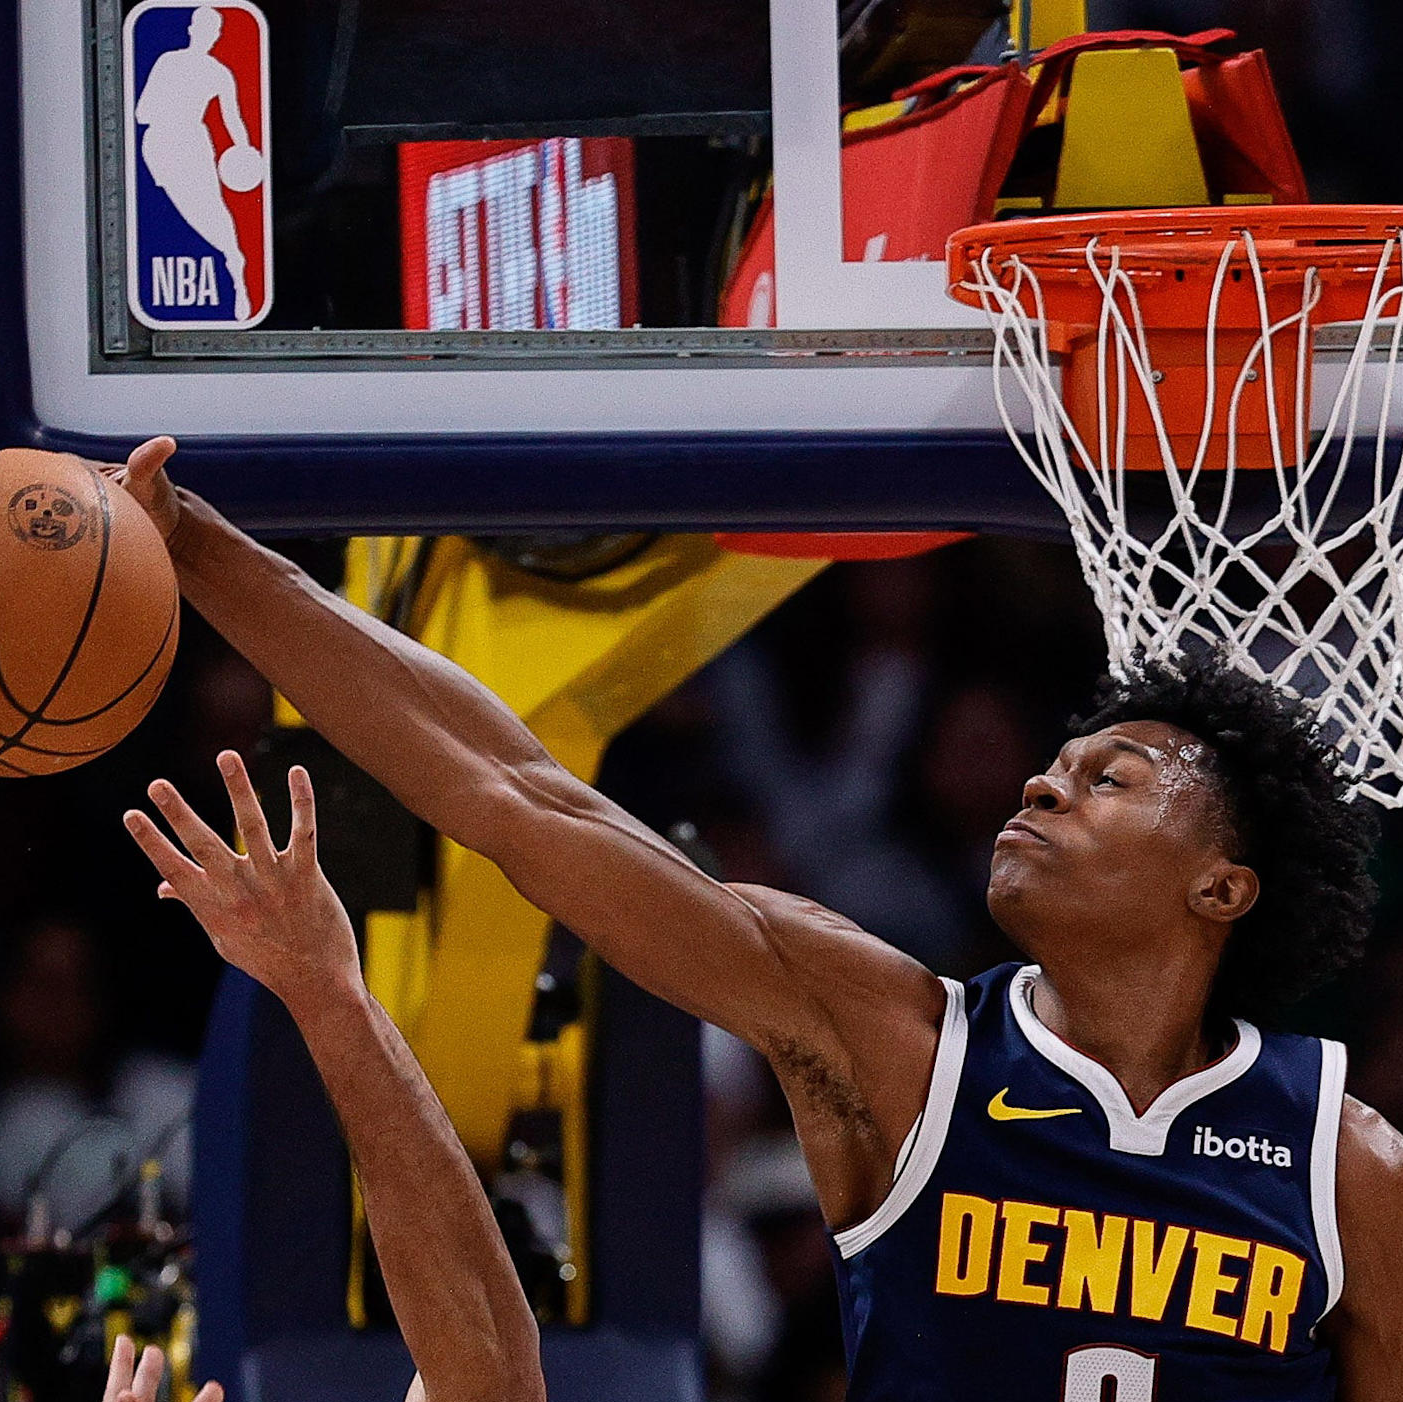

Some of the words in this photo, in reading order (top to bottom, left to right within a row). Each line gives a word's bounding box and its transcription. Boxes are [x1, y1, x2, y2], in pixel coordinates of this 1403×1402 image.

[152, 256, 219, 306] NBA
[1193, 1125, 1292, 1168] ibotta
[934, 1191, 1307, 1355] DENVER
